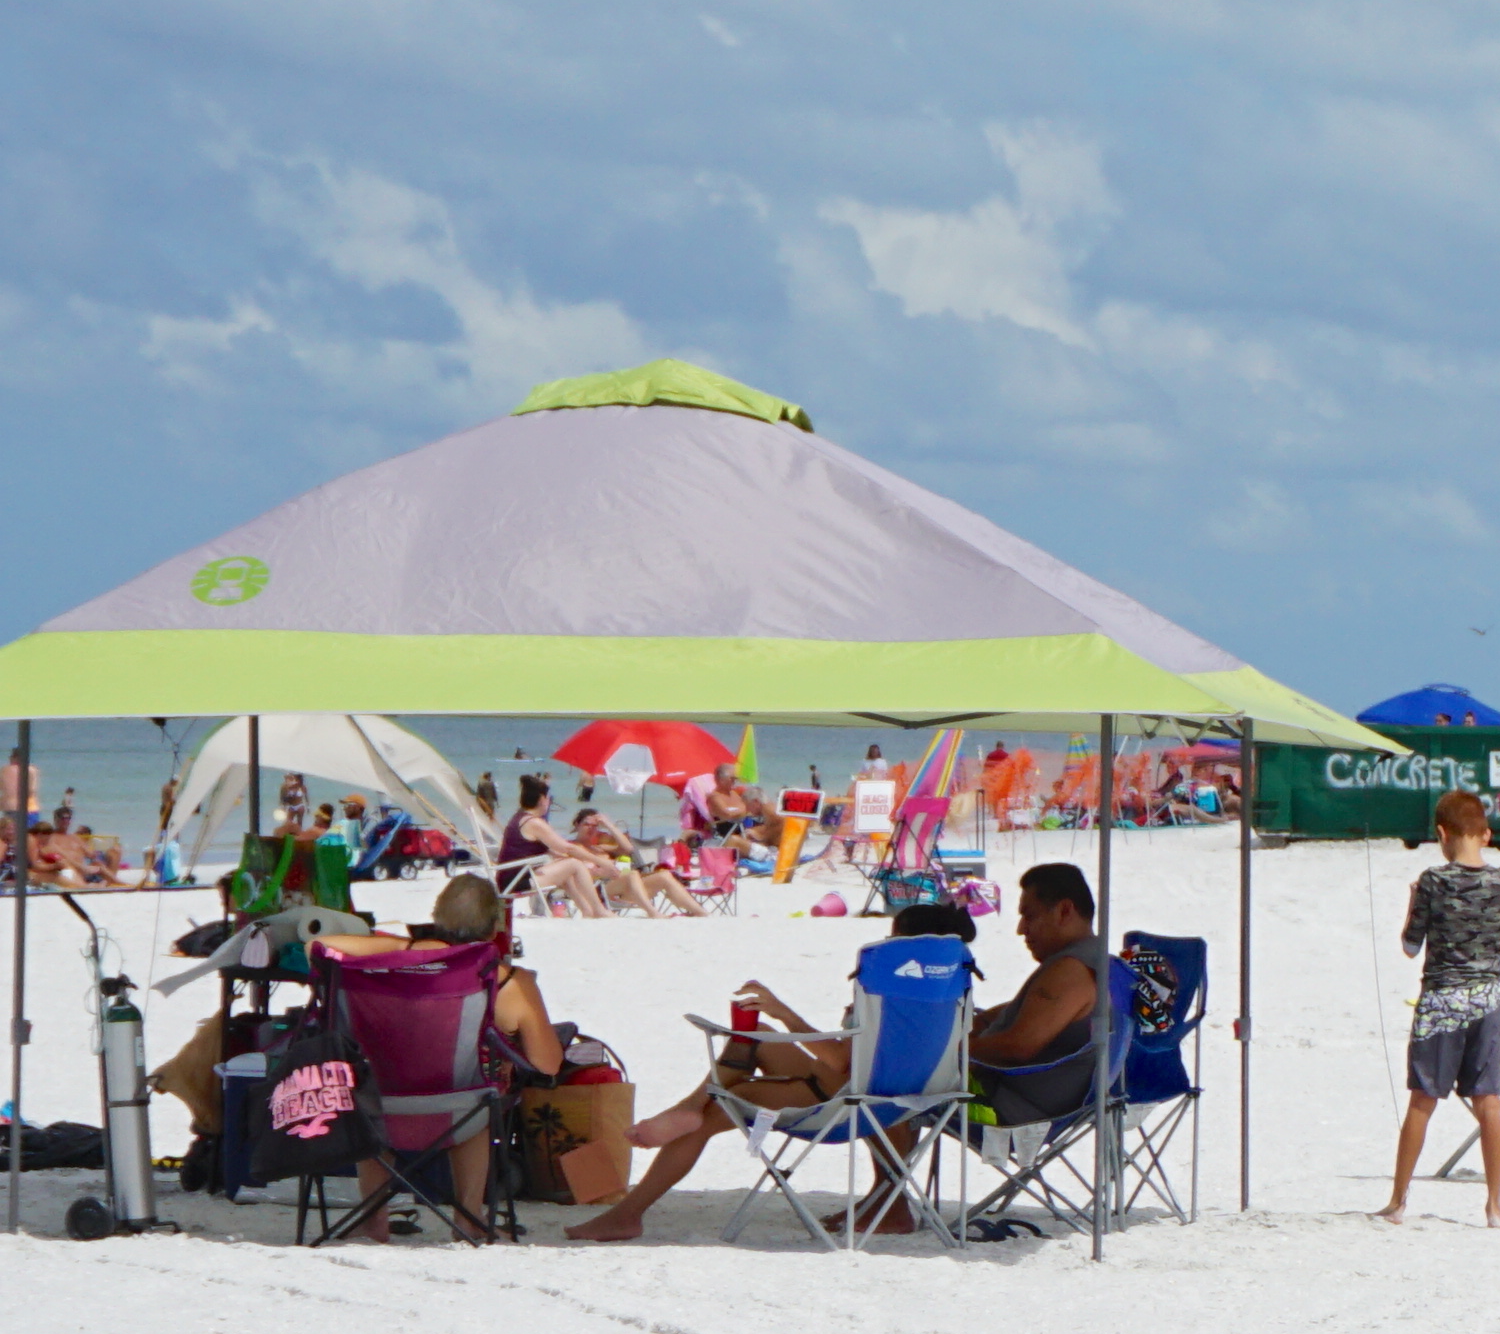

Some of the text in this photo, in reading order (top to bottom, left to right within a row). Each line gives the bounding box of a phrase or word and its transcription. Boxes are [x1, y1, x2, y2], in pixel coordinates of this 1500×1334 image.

[1325, 752, 1480, 793] CONCRETE
[861, 805, 889, 815] CLOSED
[862, 794, 888, 804] BEACH
[272, 1086, 354, 1130] BEACH
